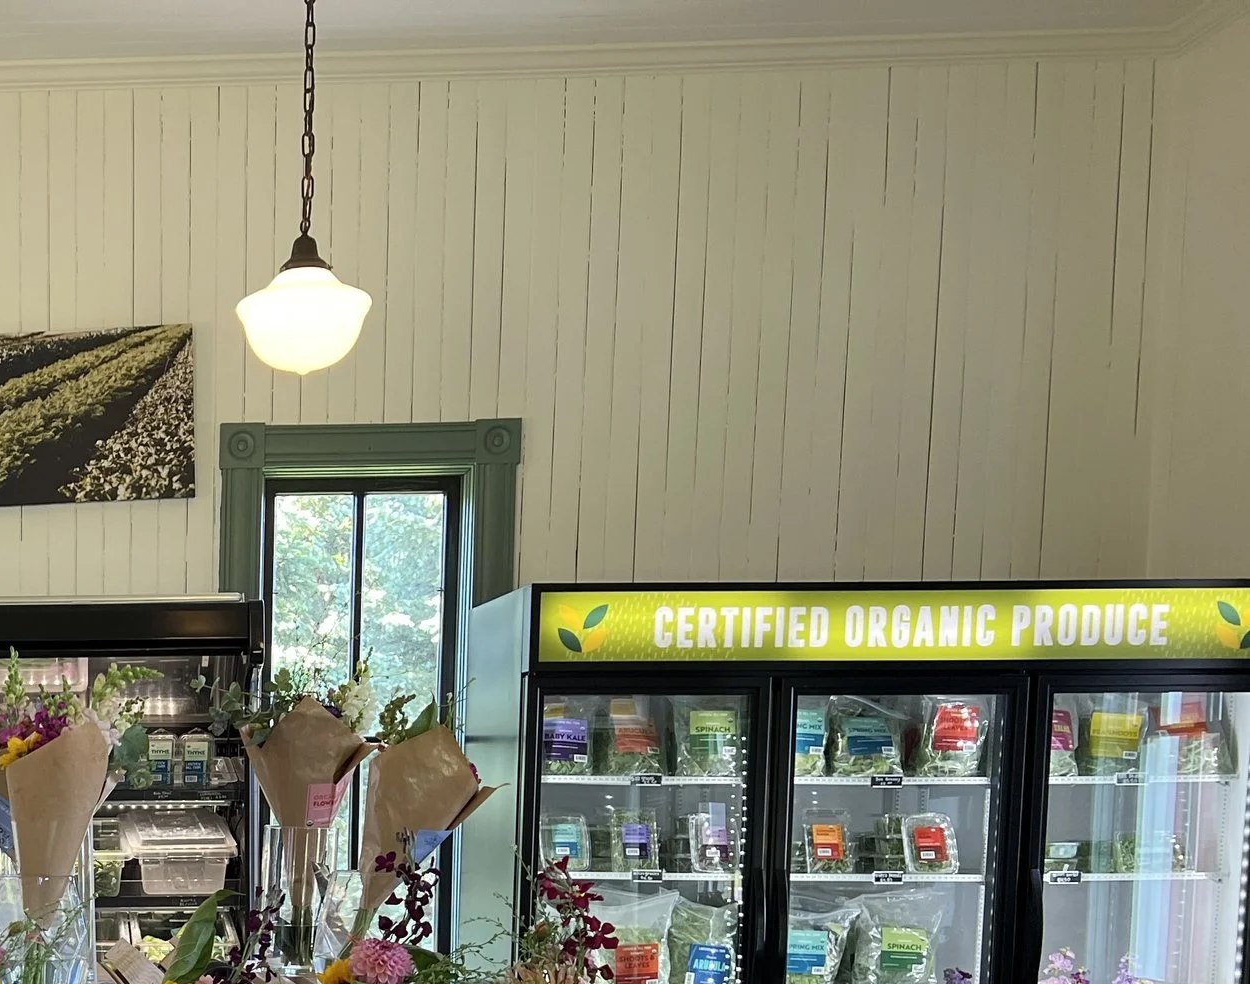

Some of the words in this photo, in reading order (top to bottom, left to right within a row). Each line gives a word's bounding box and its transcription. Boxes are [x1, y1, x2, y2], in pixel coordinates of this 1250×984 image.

[654, 605, 830, 649] CERTIFIED
[843, 603, 996, 648] ORGANIC
[1011, 603, 1170, 647] PRODUCE
[694, 726, 731, 734] SPINACH
[544, 733, 565, 742] BABY
[566, 733, 586, 742] KALE
[789, 943, 810, 951] PRING
[811, 943, 825, 951] MIX
[887, 942, 922, 951] SPINACH
[693, 958, 727, 972] ARUULA
